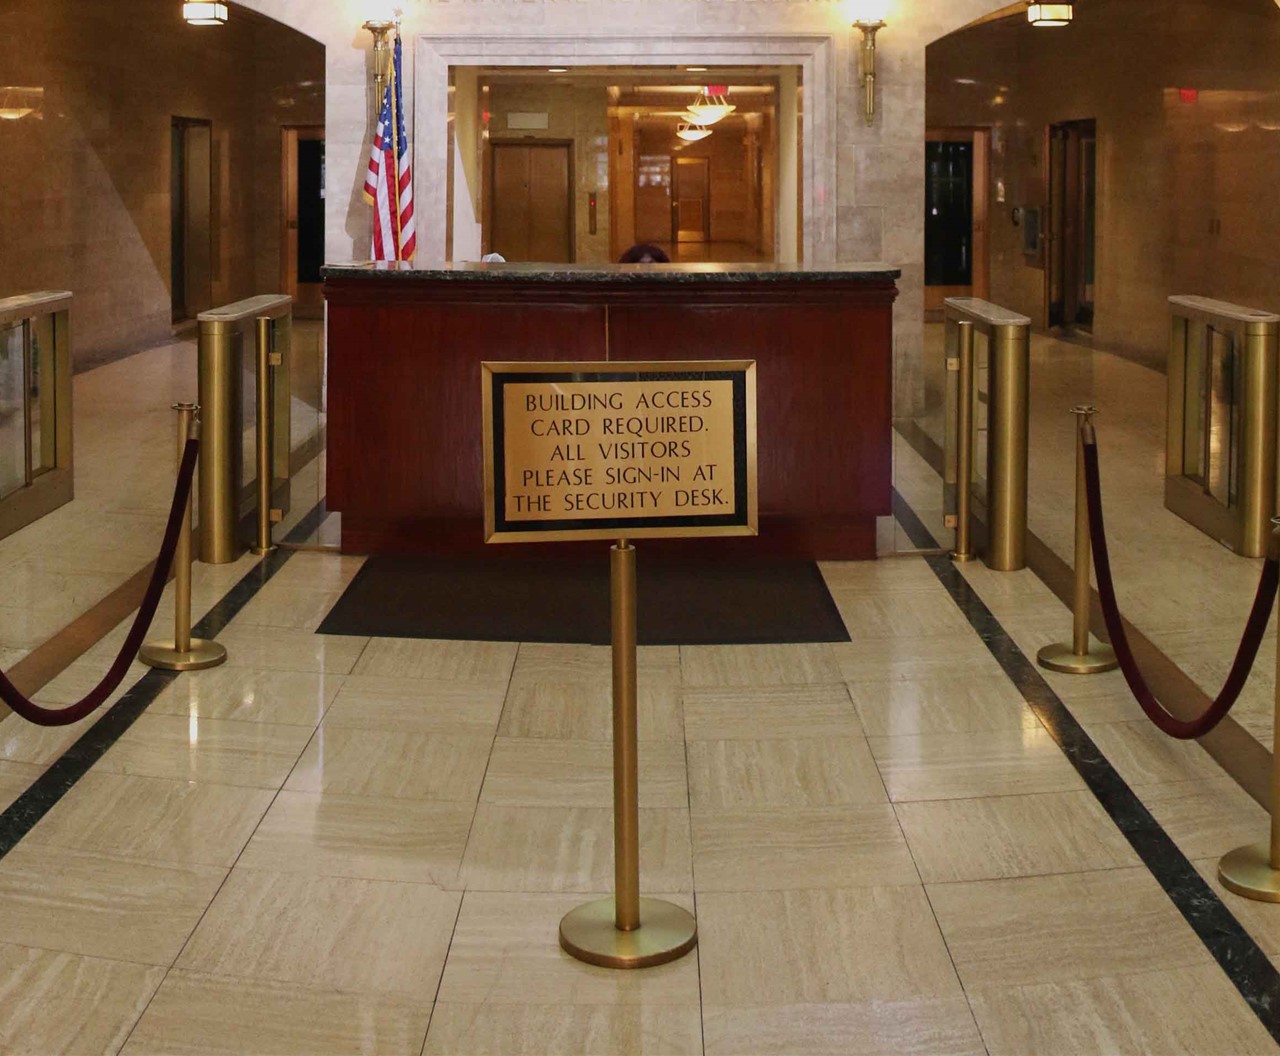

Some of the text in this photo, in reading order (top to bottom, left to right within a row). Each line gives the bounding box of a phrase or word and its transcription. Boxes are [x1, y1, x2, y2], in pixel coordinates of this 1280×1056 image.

[526, 390, 713, 412] BUILDING ACCESS
[530, 415, 709, 438] CARD REQUIRED.
[550, 440, 691, 461] ALL VISITORS
[523, 464, 718, 487] PLEASE SIGN-IN AT
[512, 488, 729, 513] THE SECURITY DESK.
